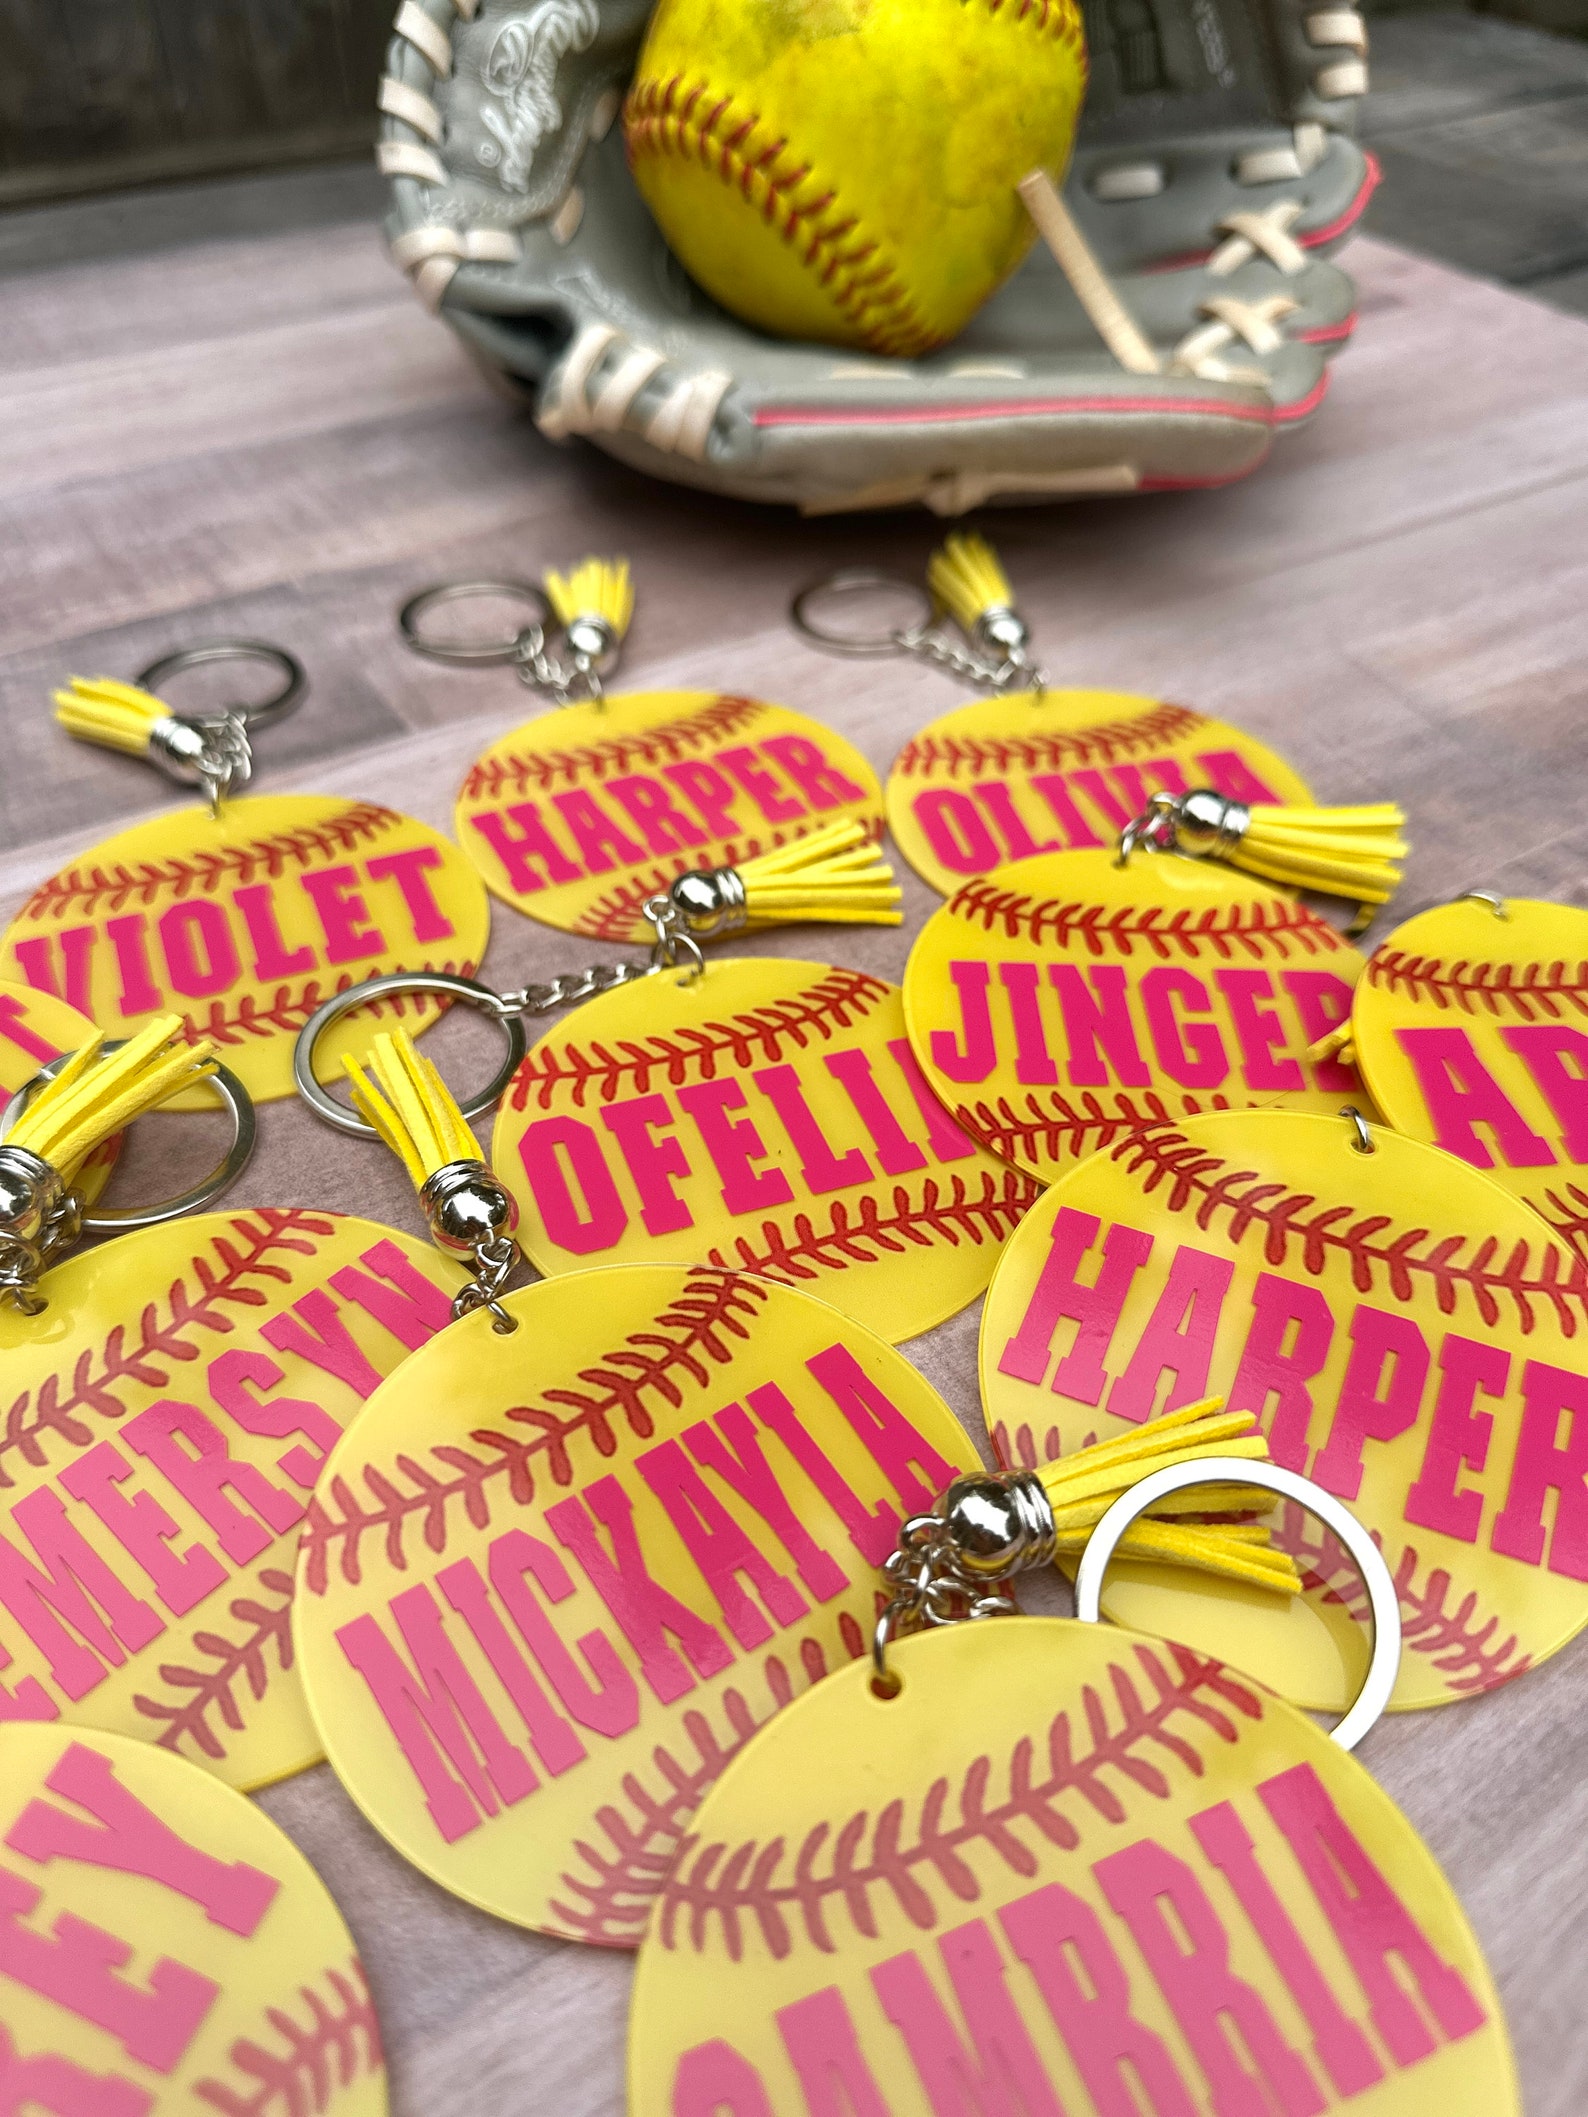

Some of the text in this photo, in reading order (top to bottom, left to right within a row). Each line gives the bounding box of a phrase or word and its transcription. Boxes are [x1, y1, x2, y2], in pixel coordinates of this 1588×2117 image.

[14, 846, 455, 1028] VIOLET
[470, 735, 868, 895] HARPER
[0, 1238, 453, 1722] MERSYN
[998, 1206, 1588, 1586] HARPER
[334, 1342, 961, 1844] MICKAYLA
